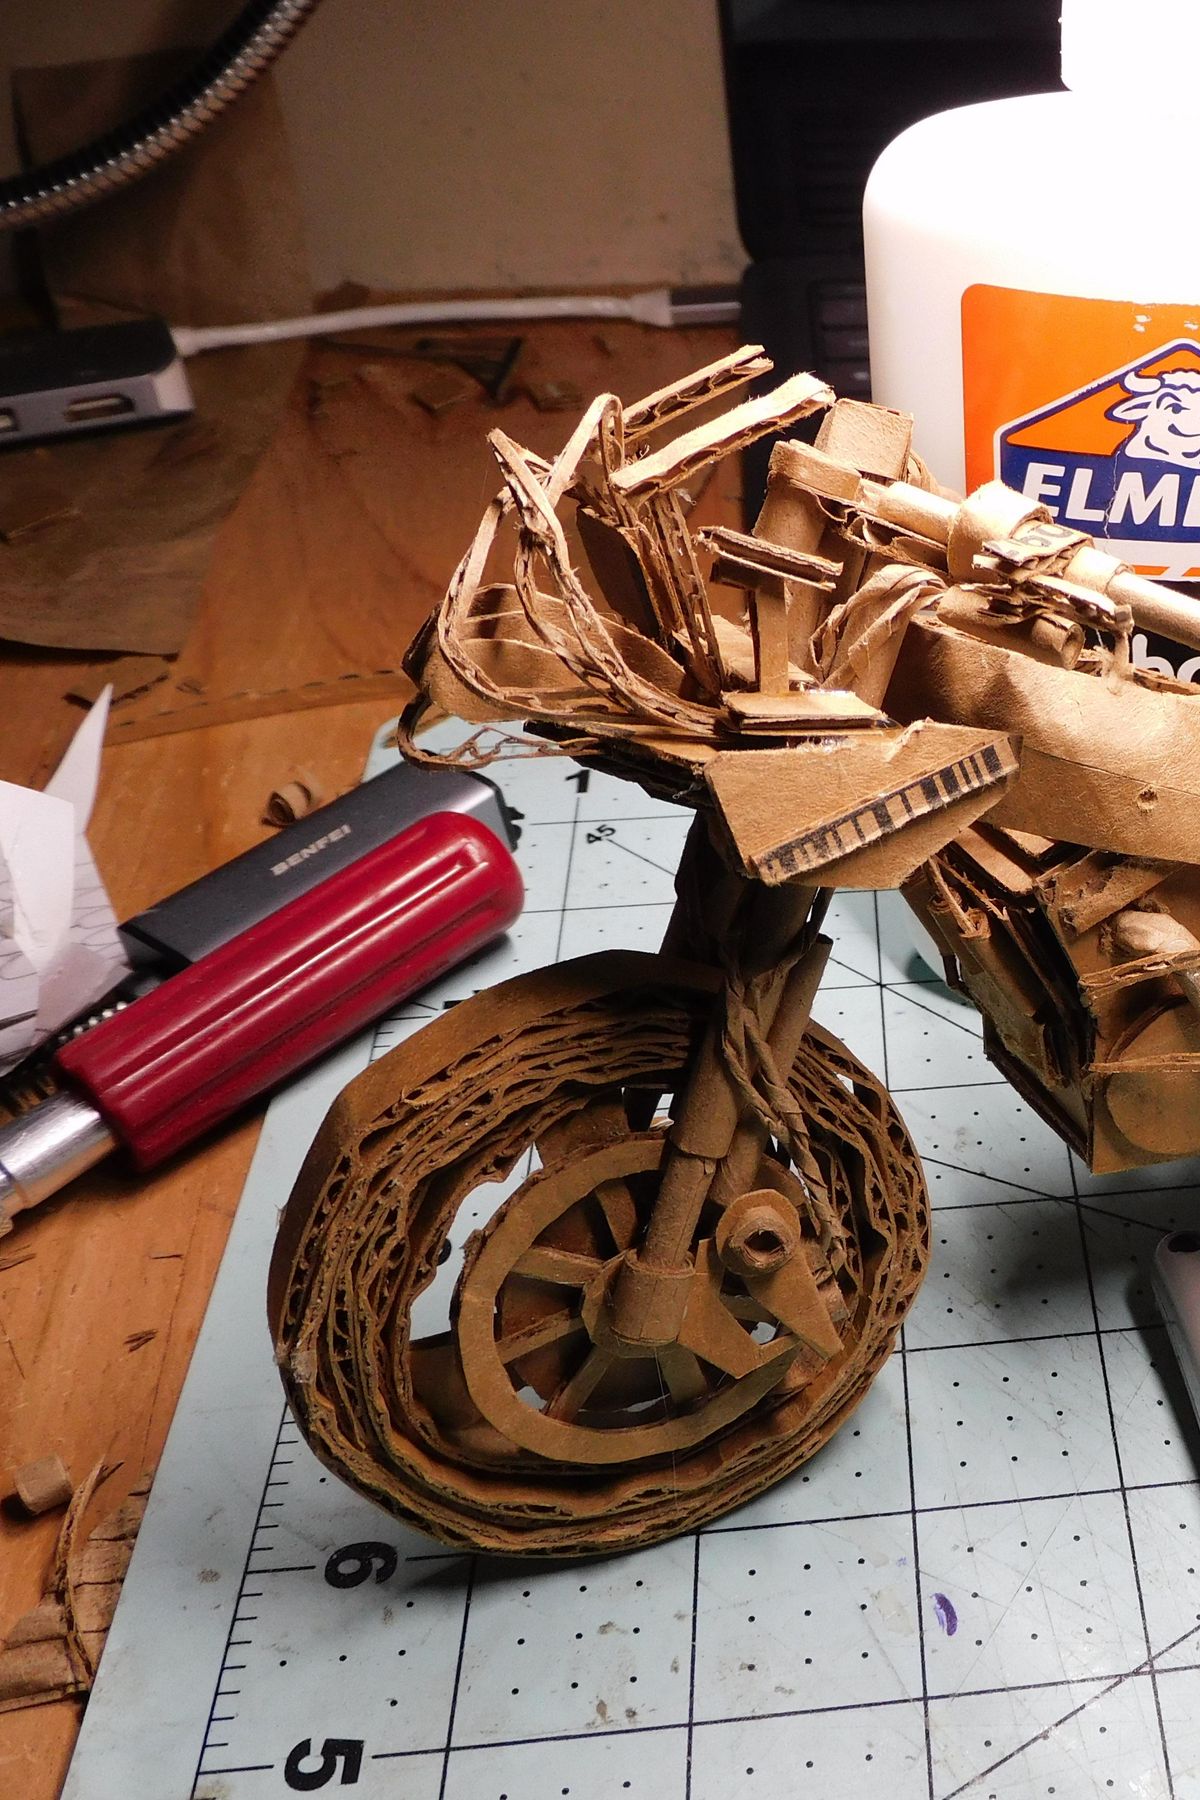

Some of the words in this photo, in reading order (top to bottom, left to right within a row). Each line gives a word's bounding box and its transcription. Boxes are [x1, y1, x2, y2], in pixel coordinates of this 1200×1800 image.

[565, 769, 591, 793] 1
[586, 824, 616, 844] 45
[284, 1738, 364, 1791] 5
